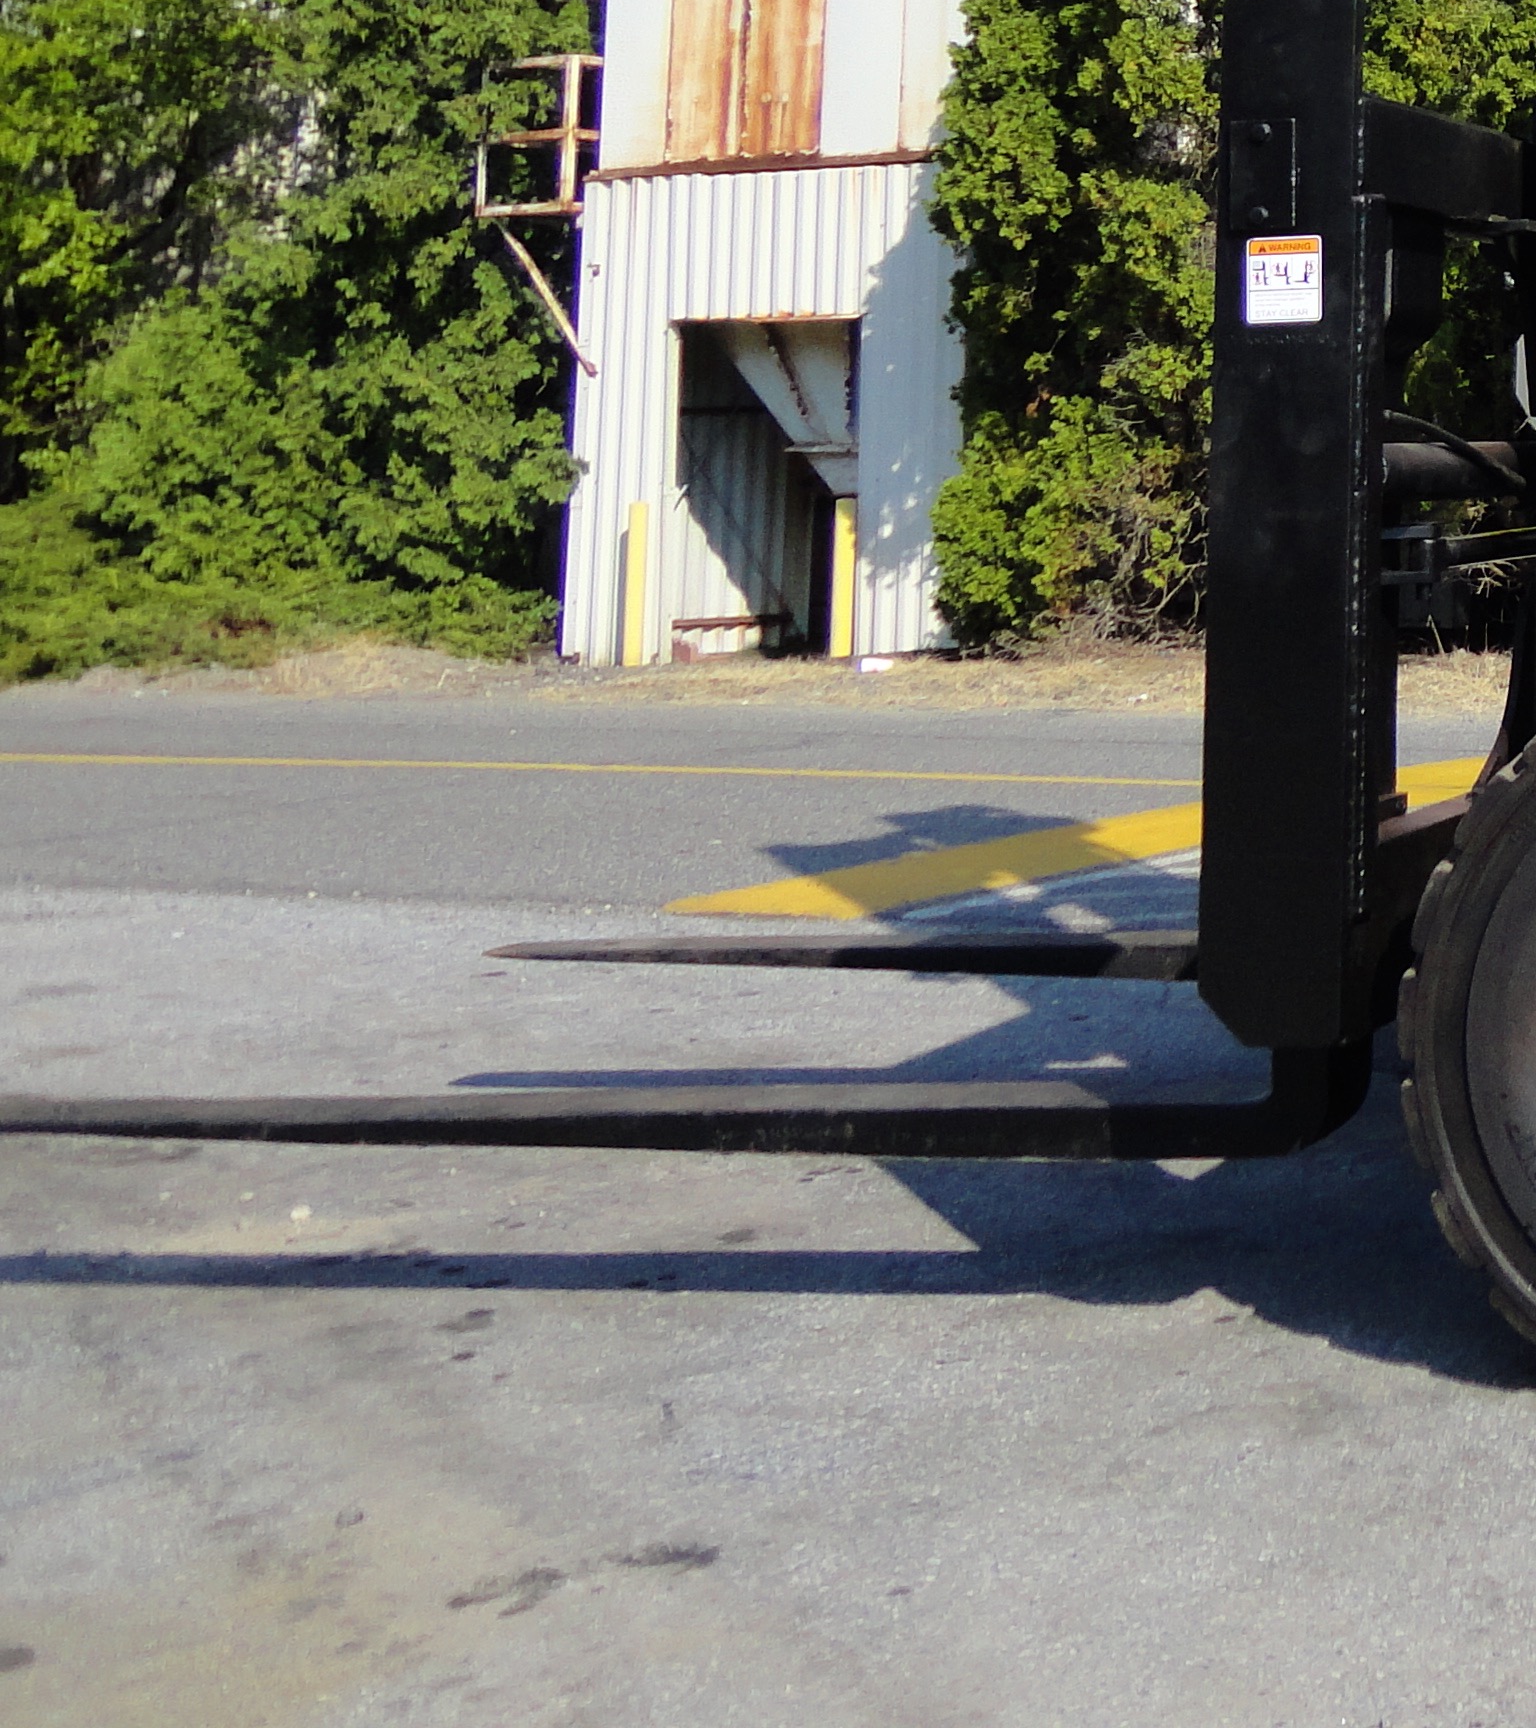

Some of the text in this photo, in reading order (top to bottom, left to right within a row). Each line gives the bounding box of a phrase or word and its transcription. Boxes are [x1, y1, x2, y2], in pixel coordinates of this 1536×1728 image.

[1268, 242, 1311, 252] WARNING
[1255, 308, 1309, 318] STAY CLEAR
